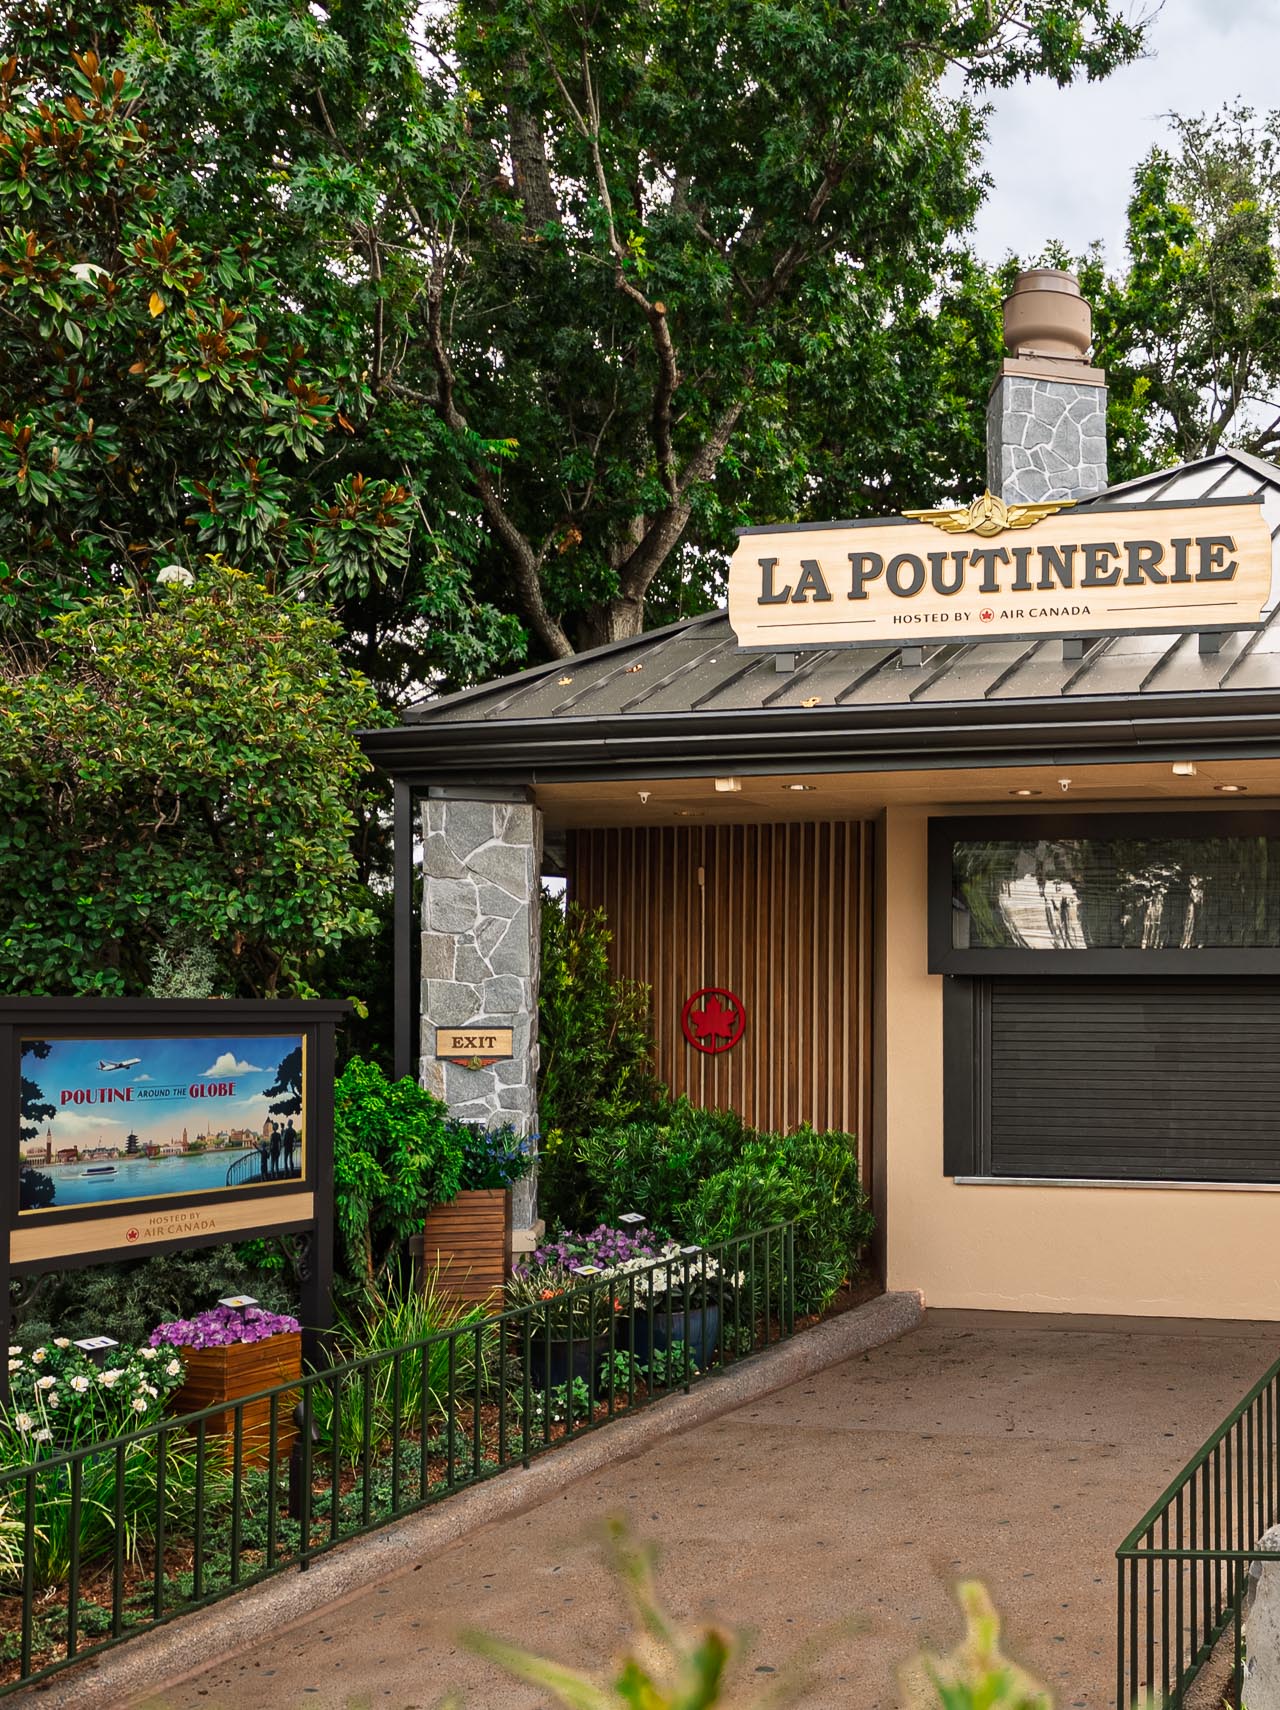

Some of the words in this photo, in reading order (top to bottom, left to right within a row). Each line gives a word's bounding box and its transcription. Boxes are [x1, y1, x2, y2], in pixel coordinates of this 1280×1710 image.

[757, 556, 833, 605] LA
[847, 535, 1239, 599] POUTINERIE
[893, 612, 949, 624] HOSTED
[954, 612, 971, 622] BY
[1000, 608, 1024, 619] AIR
[1029, 605, 1091, 618] CANADA
[451, 1036, 497, 1048] EXIT
[60, 1087, 134, 1105] POUTINE
[137, 1087, 171, 1099] AROUND
[172, 1086, 187, 1097] THE
[189, 1082, 237, 1099] GLOBE
[149, 1213, 186, 1225] HOSTED
[187, 1211, 201, 1222] BY
[143, 1227, 165, 1239] AIR
[167, 1219, 216, 1234] CANADA
